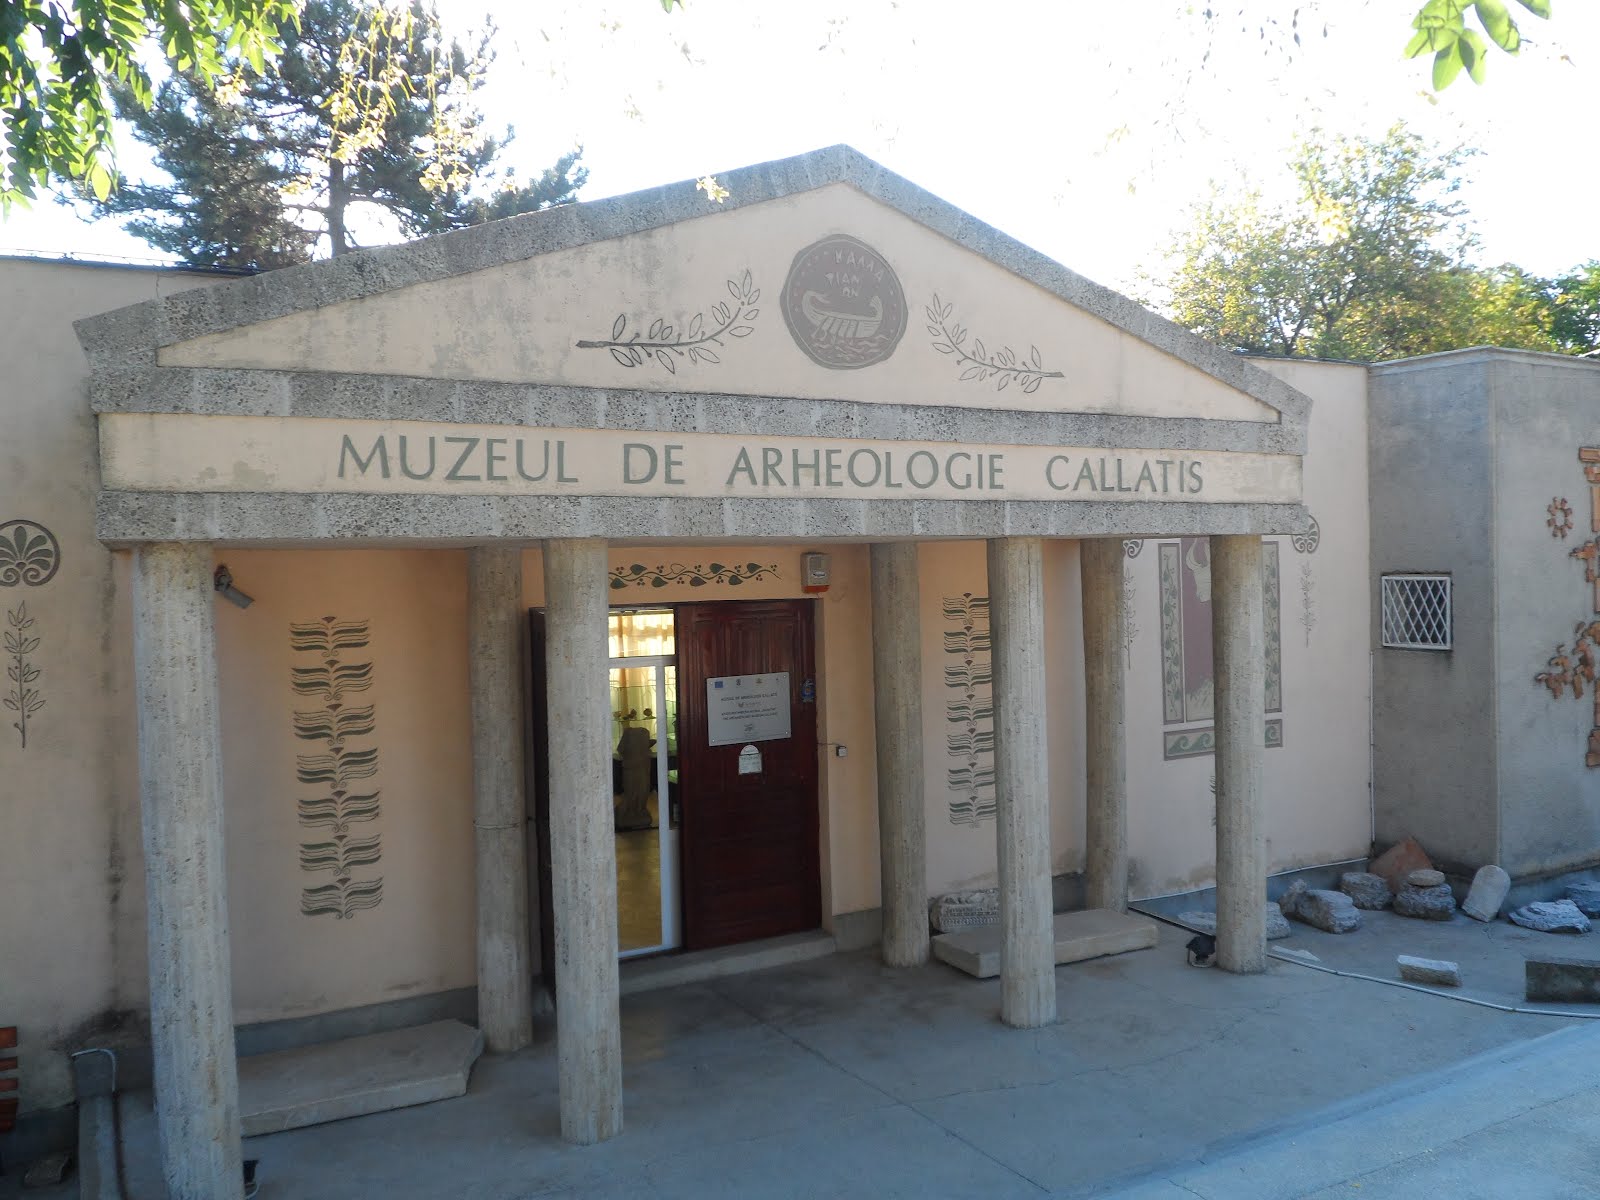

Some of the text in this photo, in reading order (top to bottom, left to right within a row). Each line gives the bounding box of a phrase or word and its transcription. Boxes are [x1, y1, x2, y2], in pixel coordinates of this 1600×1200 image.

[338, 434, 1203, 494] MUZEUL DE ARHEOLOGIE CALLATIS
